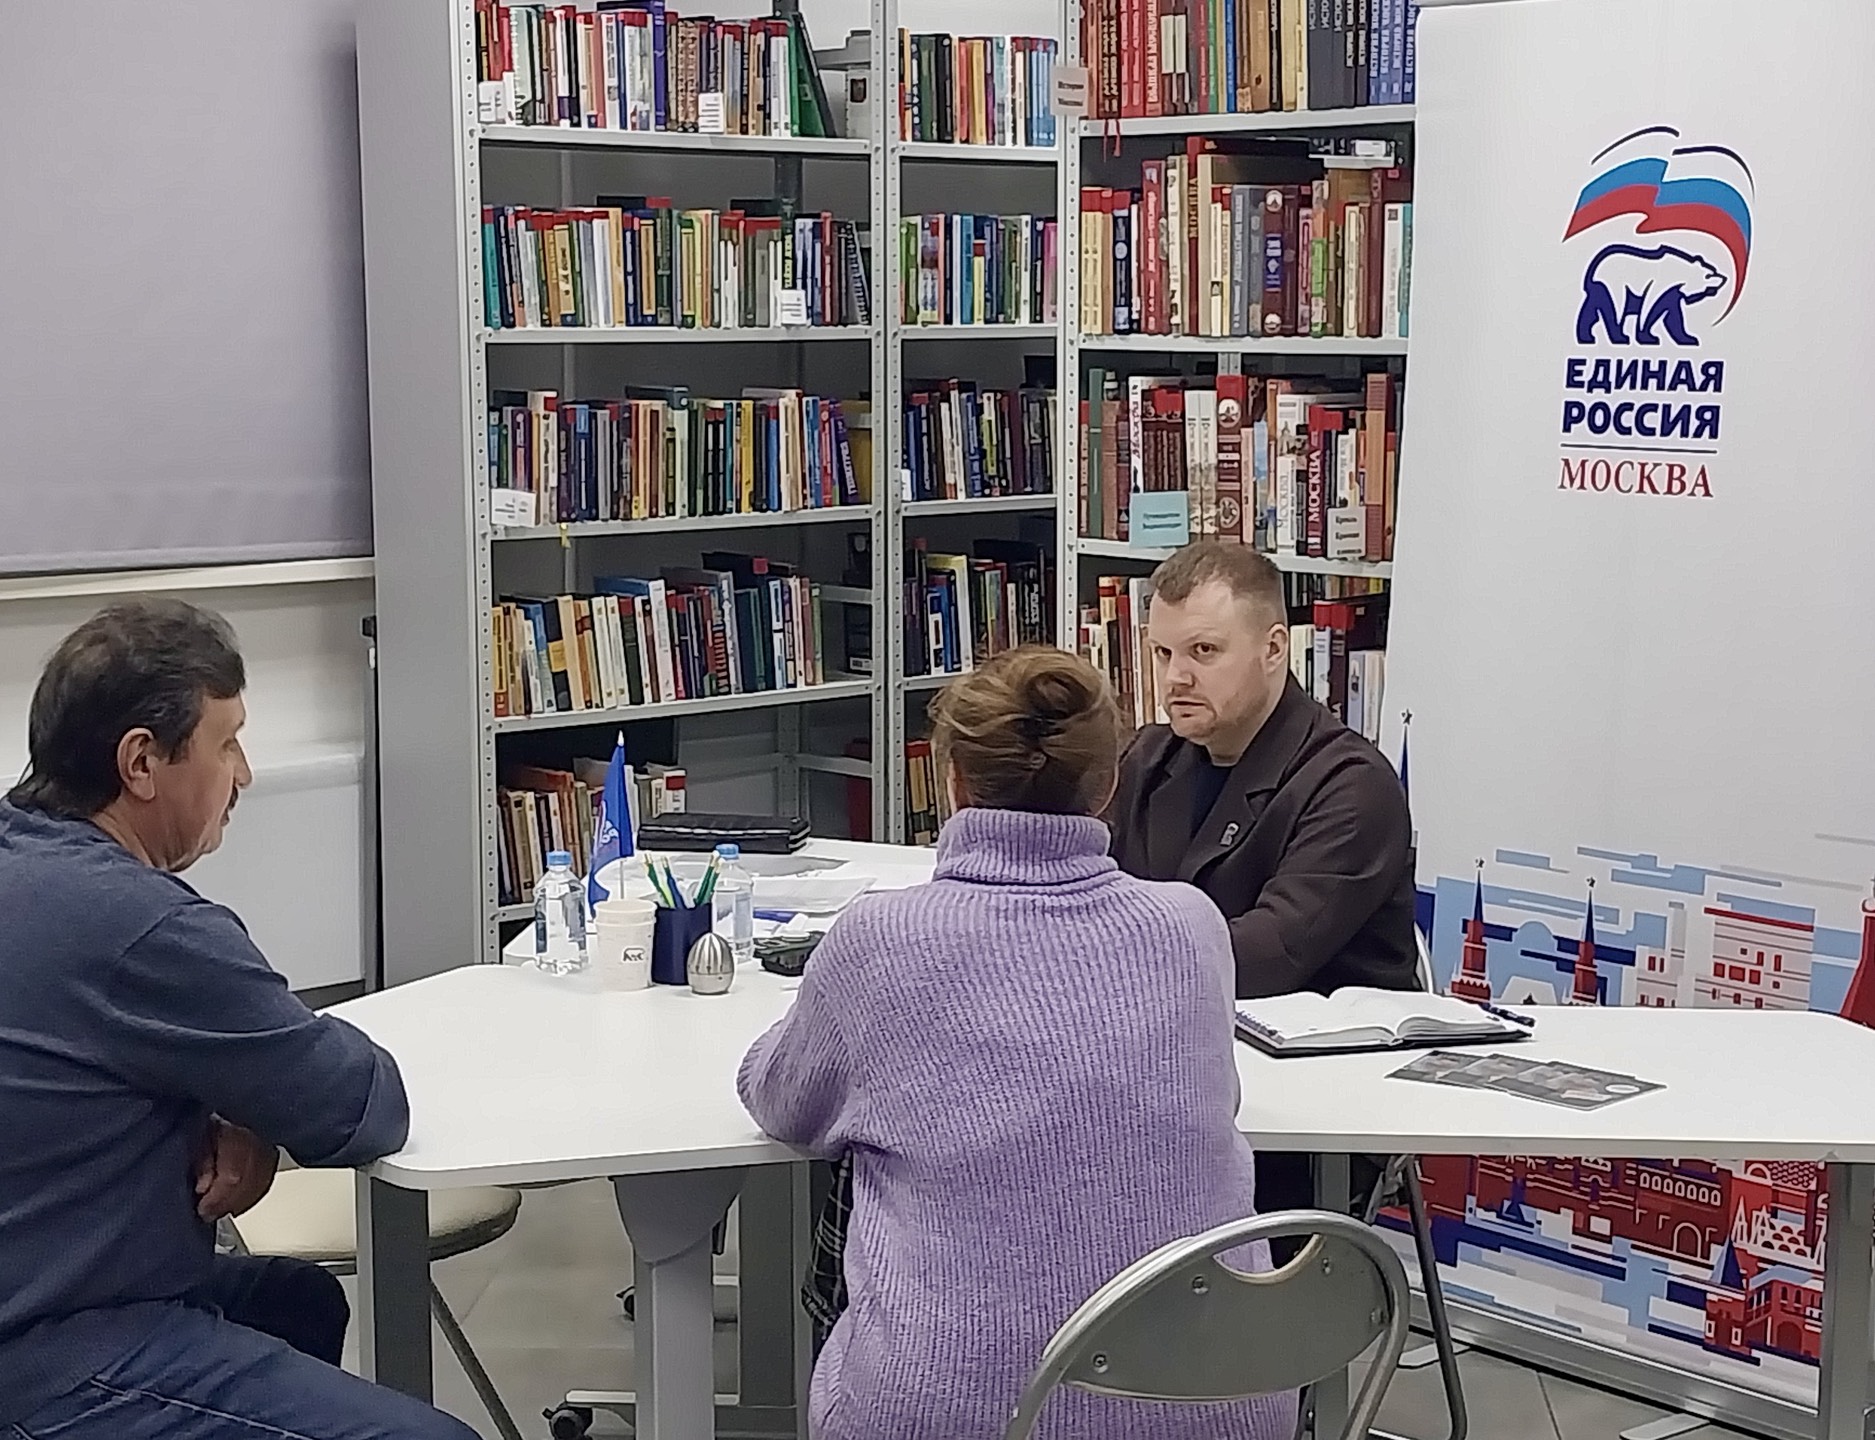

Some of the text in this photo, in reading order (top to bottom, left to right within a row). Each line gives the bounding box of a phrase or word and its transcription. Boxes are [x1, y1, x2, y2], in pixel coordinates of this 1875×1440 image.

[1565, 358, 1725, 394] ЕДИНАЯ
[1562, 400, 1721, 439] РОССИЯ
[1308, 450, 1321, 523] МОСКВА
[1558, 458, 1714, 498] МОСКВА
